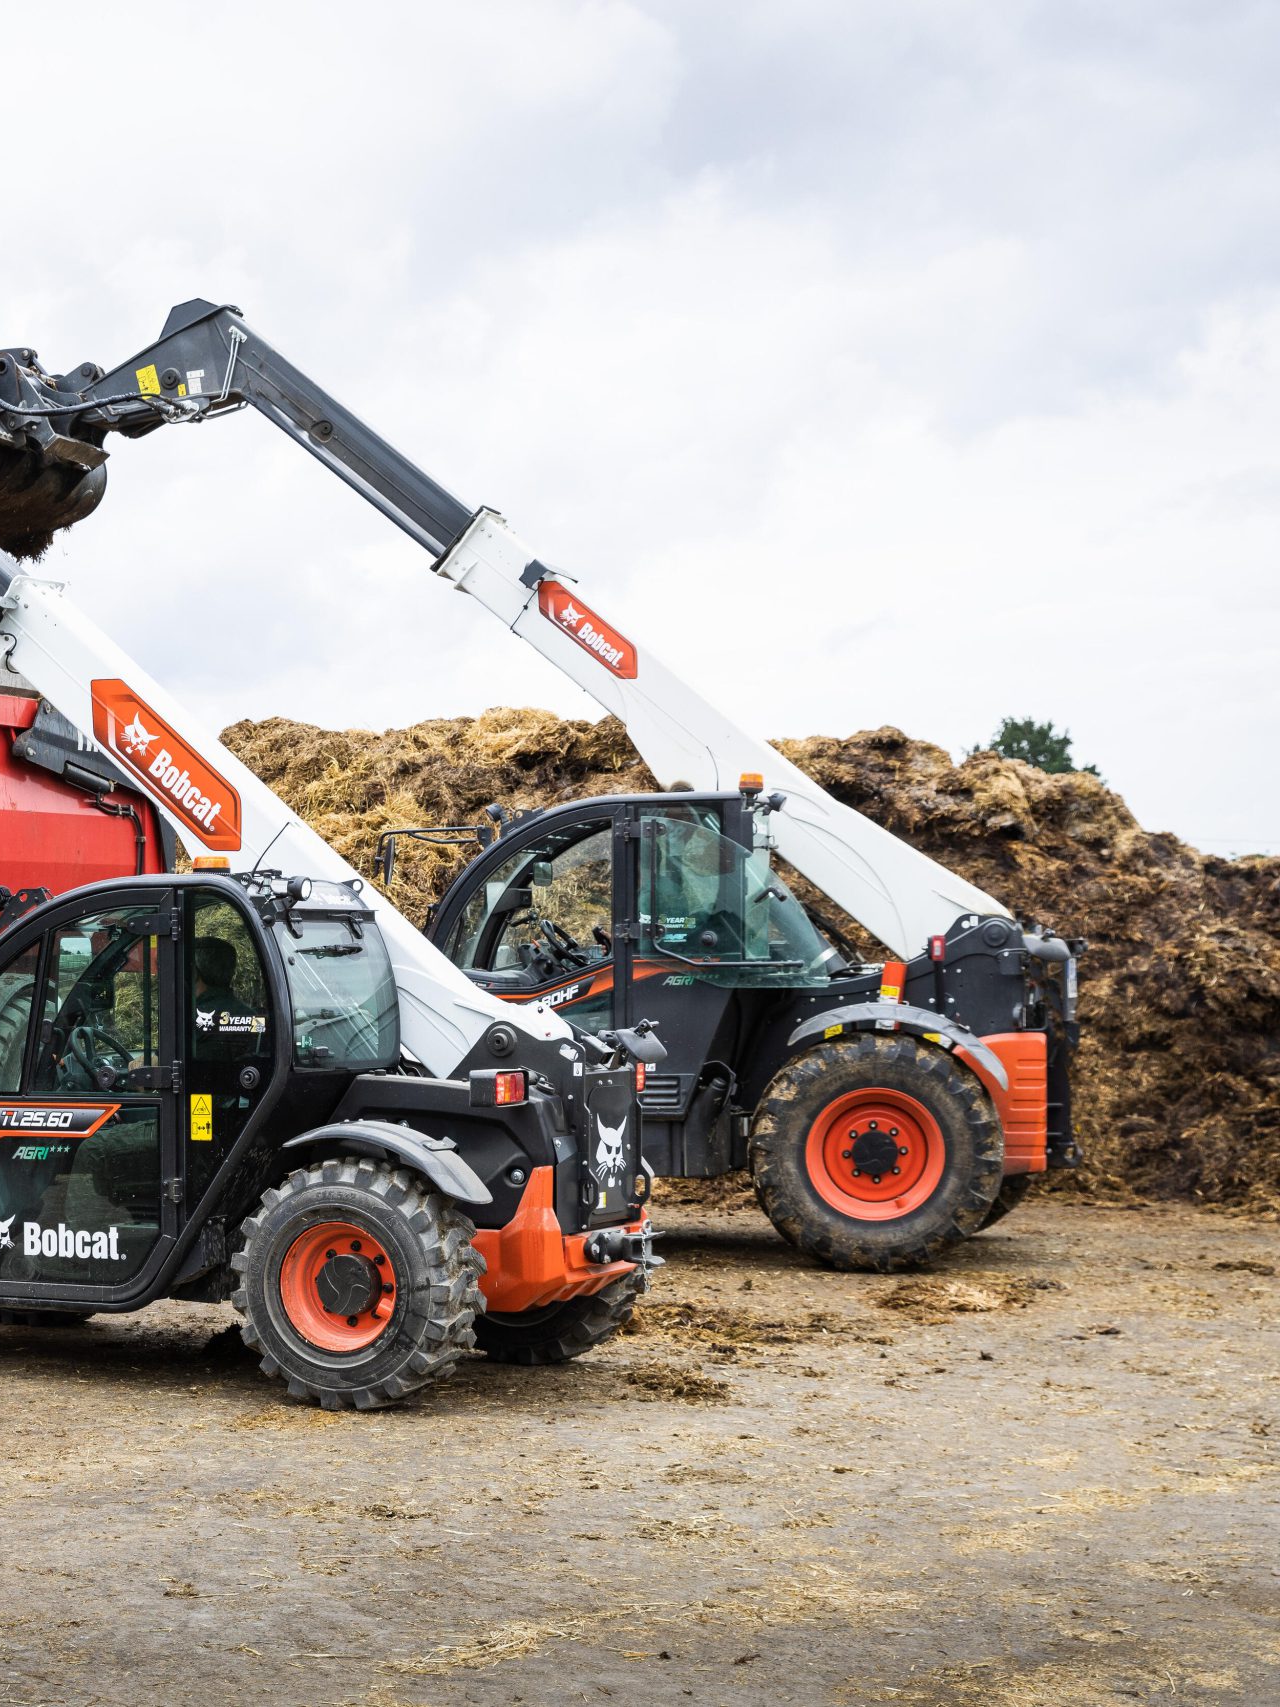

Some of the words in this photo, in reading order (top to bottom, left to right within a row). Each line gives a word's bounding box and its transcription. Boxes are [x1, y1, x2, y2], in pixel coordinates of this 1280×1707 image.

[577, 622, 624, 667] Bobcat
[148, 748, 222, 829] Bobcat
[662, 975, 695, 986] AGRI
[219, 1011, 231, 1024] 3
[230, 1016, 251, 1025] YEAR
[1, 1111, 73, 1128] TL25.60
[12, 1146, 49, 1160] AGRI
[23, 1221, 120, 1260] Bobcat
